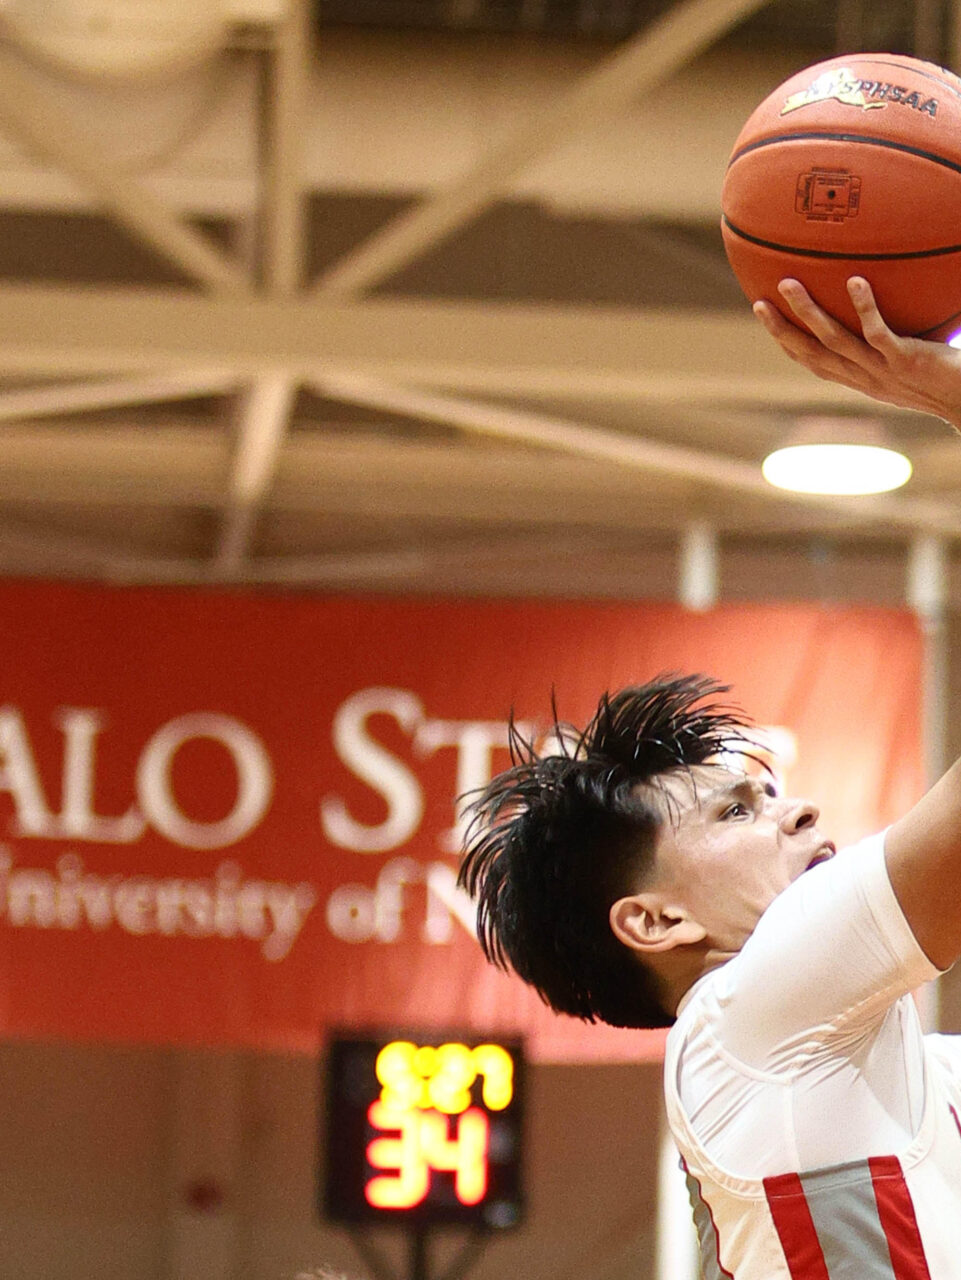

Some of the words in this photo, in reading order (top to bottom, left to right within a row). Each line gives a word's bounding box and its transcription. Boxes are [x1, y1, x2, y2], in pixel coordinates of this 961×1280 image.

[0, 845, 318, 963] niversity
[325, 856, 426, 944] of
[364, 1100, 489, 1209] 34
